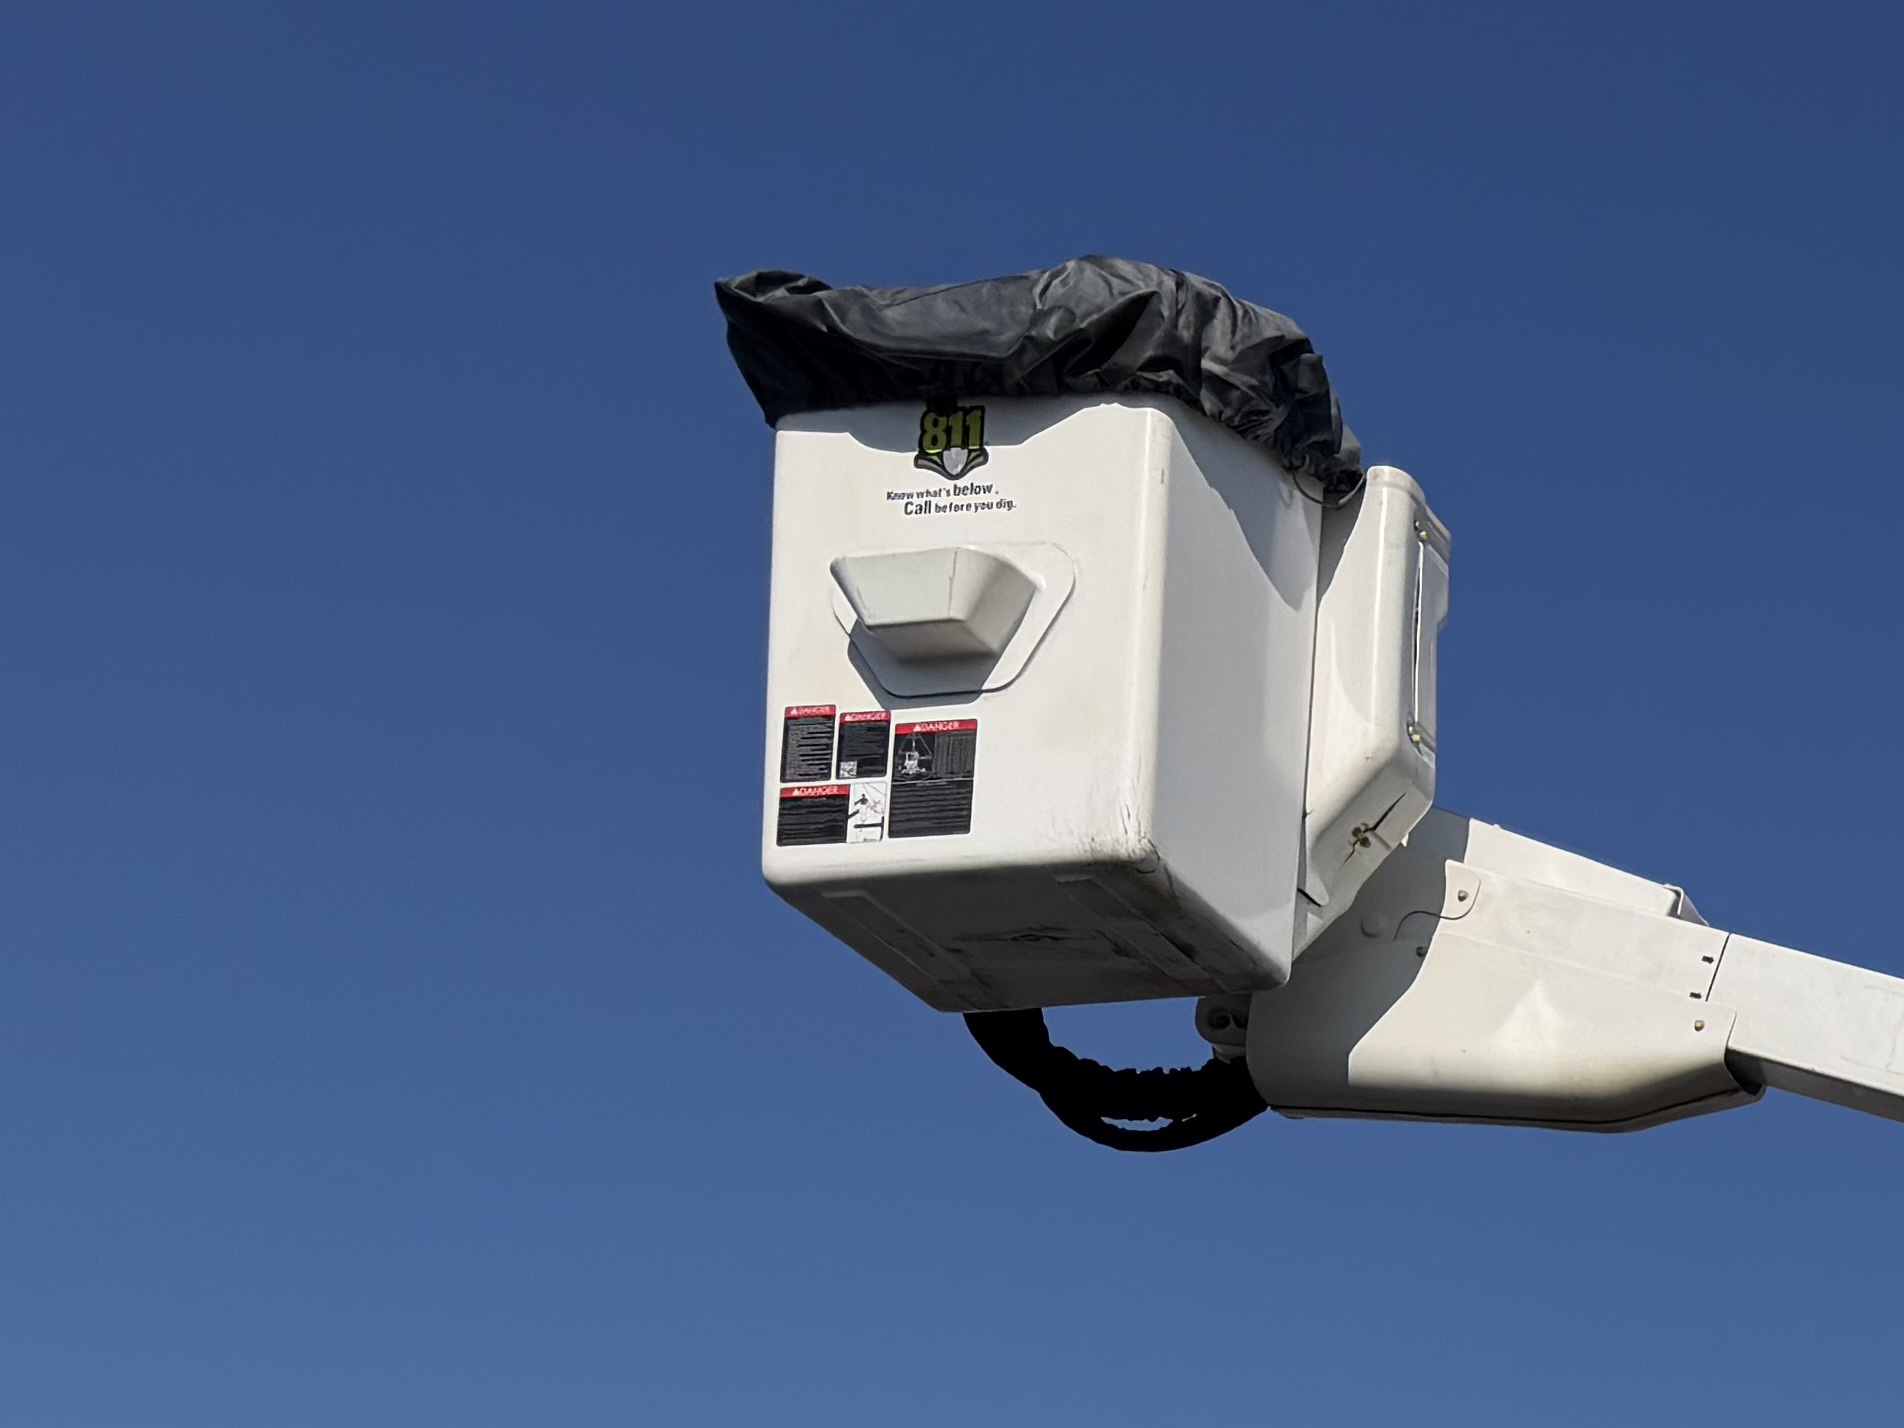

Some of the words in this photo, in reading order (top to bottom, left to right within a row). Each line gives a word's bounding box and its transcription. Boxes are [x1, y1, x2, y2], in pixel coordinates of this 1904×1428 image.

[921, 408, 984, 454] 811
[904, 500, 932, 516] Call
[935, 502, 972, 514] before
[974, 502, 994, 513] you
